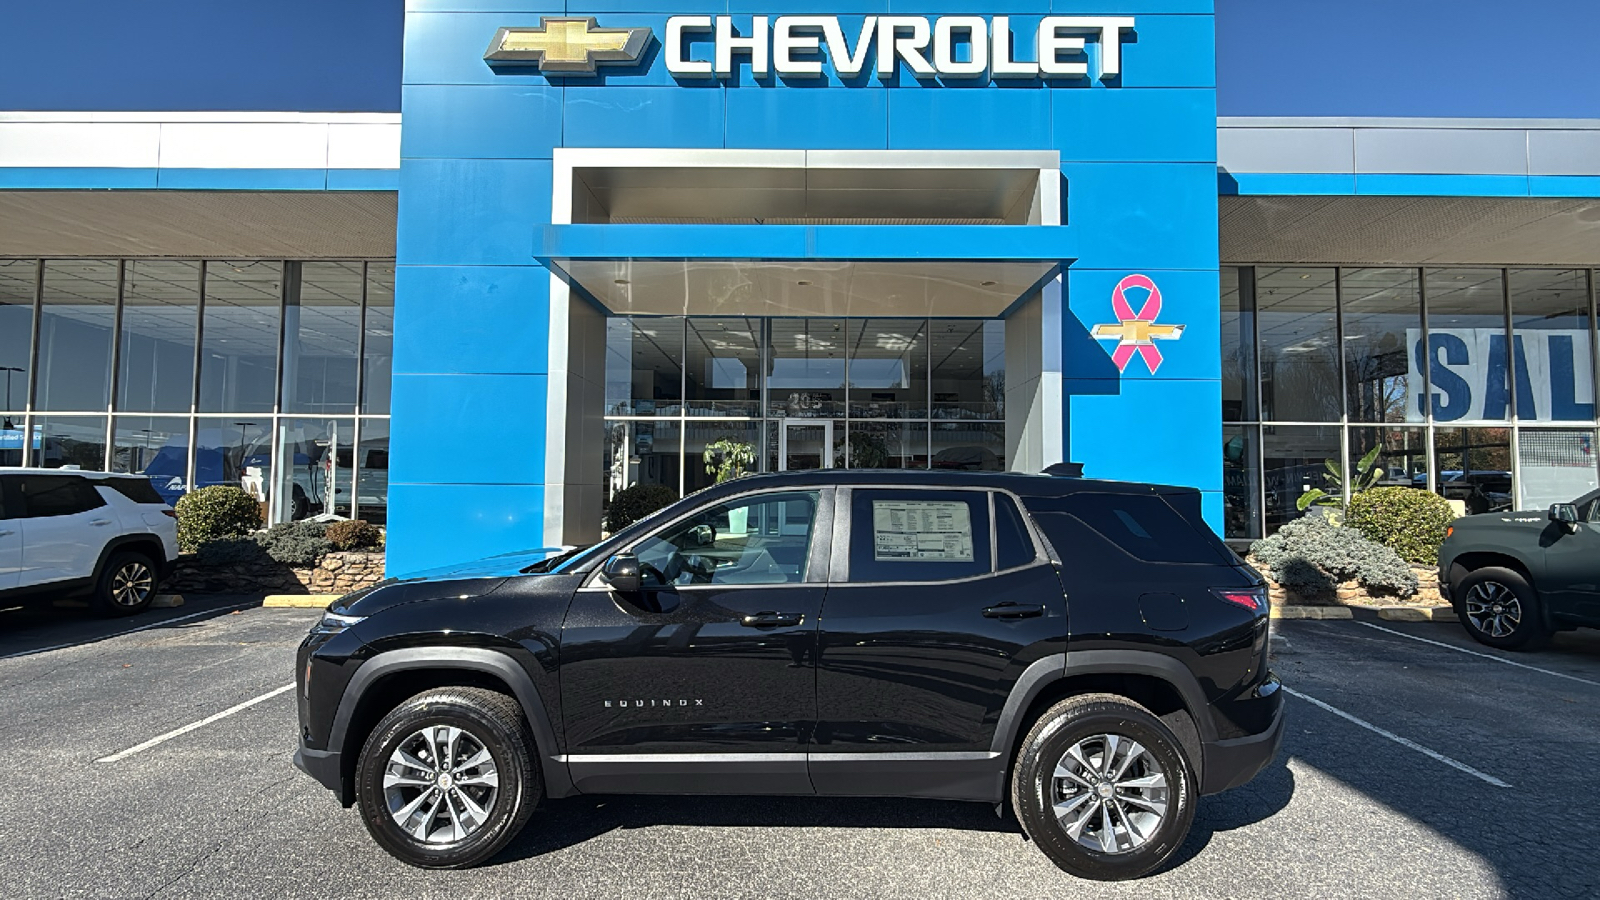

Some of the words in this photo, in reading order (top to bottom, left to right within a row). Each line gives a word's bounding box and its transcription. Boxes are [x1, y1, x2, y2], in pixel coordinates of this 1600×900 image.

[664, 16, 1135, 79] CHEVROLET
[1415, 333, 1595, 421] SAL
[789, 392, 823, 409] 205
[604, 699, 703, 708] EQUINOX
